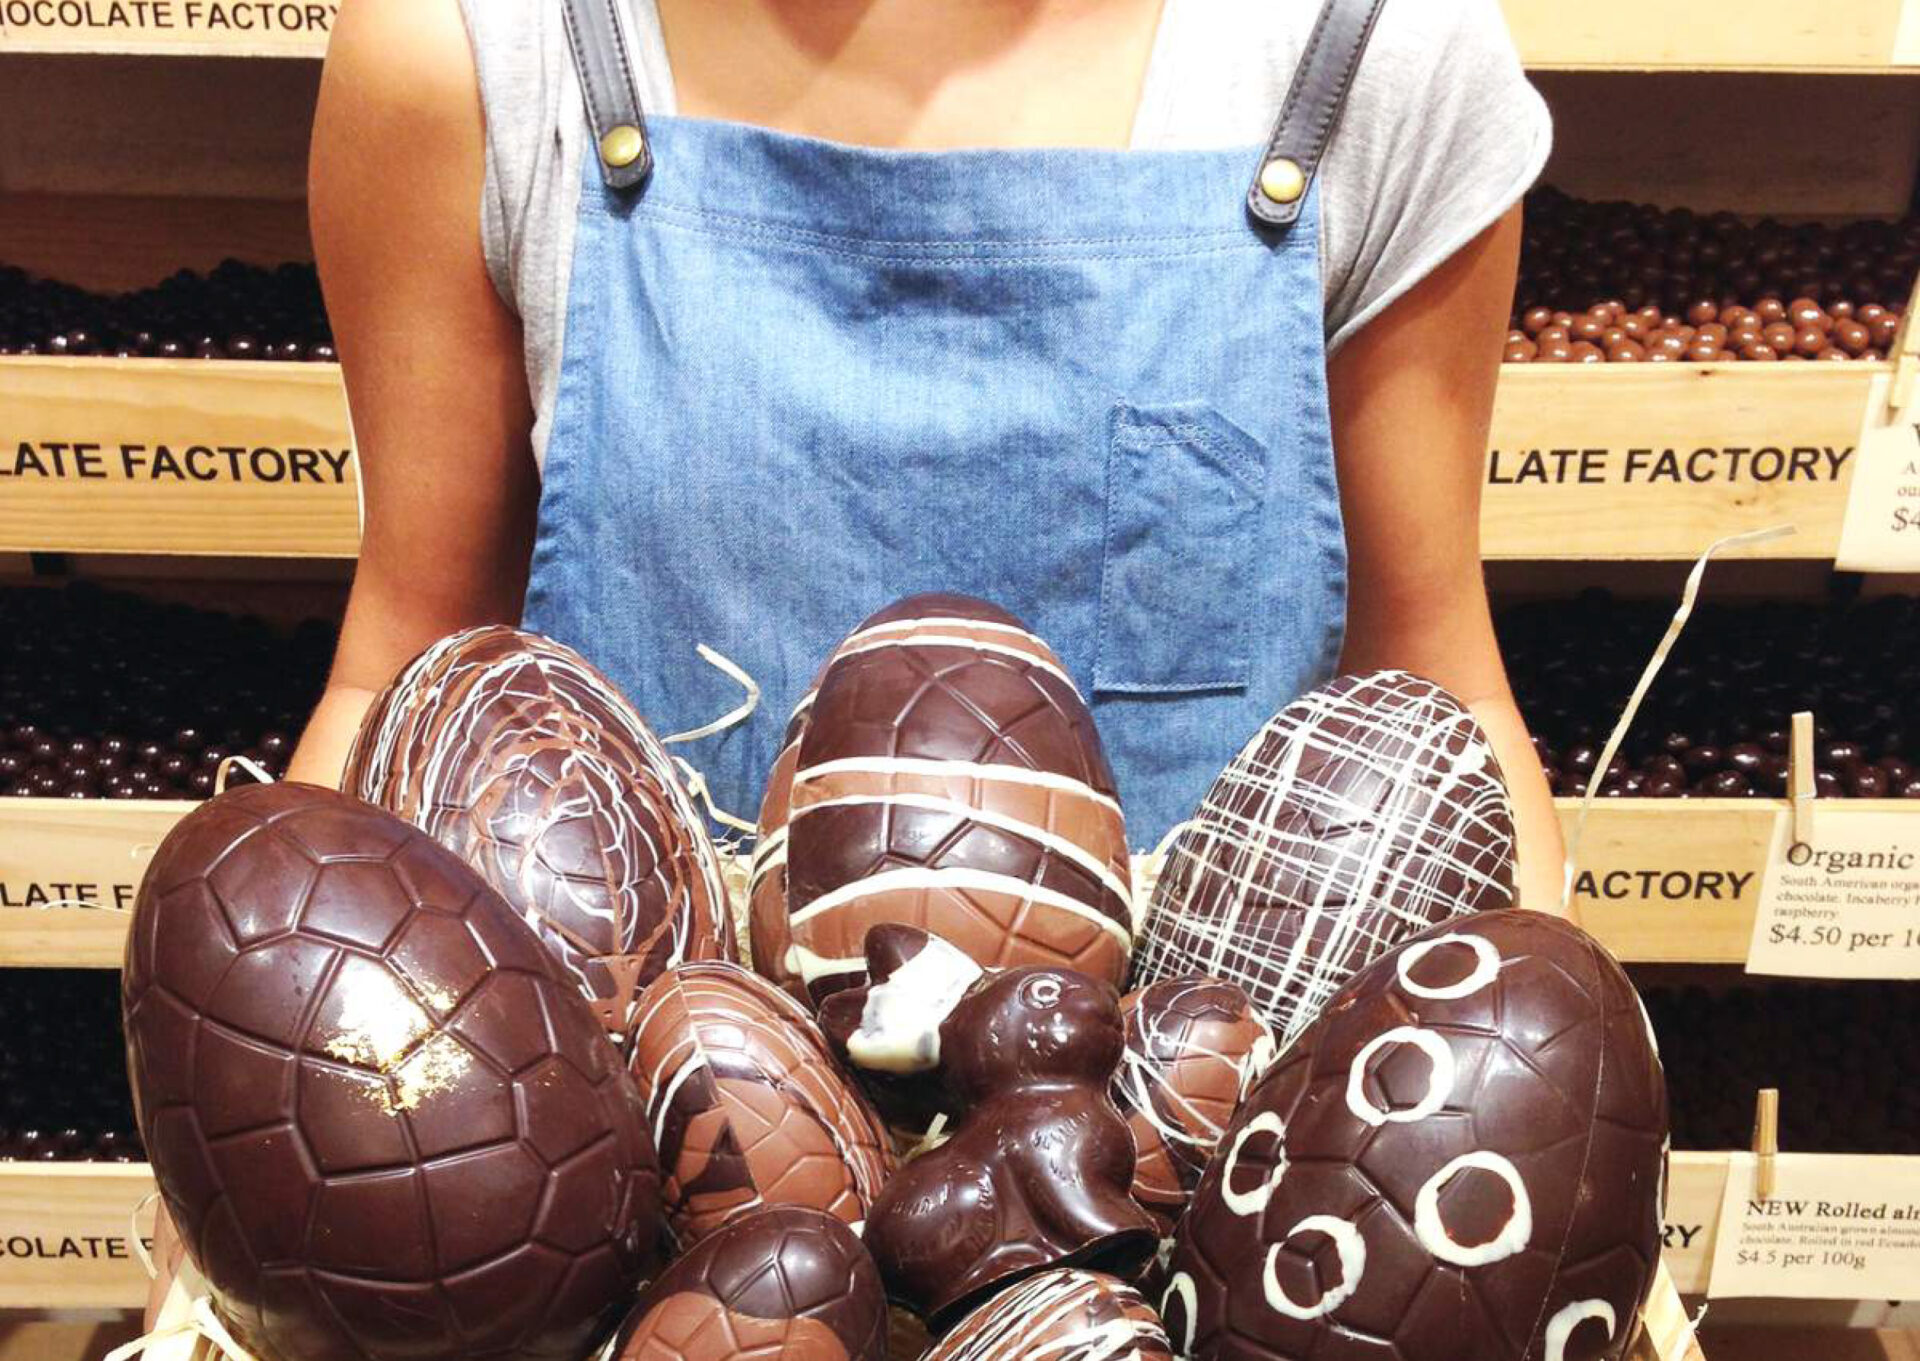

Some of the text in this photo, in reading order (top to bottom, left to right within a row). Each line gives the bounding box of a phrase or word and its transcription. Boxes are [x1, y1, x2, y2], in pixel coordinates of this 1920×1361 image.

[0, 0, 174, 28] OCOLATE
[120, 444, 350, 484] FACTORY
[1488, 447, 1855, 485] LATE FACTORY
[1787, 841, 1914, 874] Organic
[1575, 870, 1755, 900] ACTORY
[1780, 875, 1817, 887] South
[1820, 877, 1887, 889] American
[1769, 923, 1842, 946] $4.50
[1848, 931, 1894, 952] per
[1747, 1200, 1808, 1217] NEW
[1816, 1202, 1887, 1219] Rolled
[1782, 1252, 1815, 1268] per
[1823, 1251, 1866, 1269] 100g
